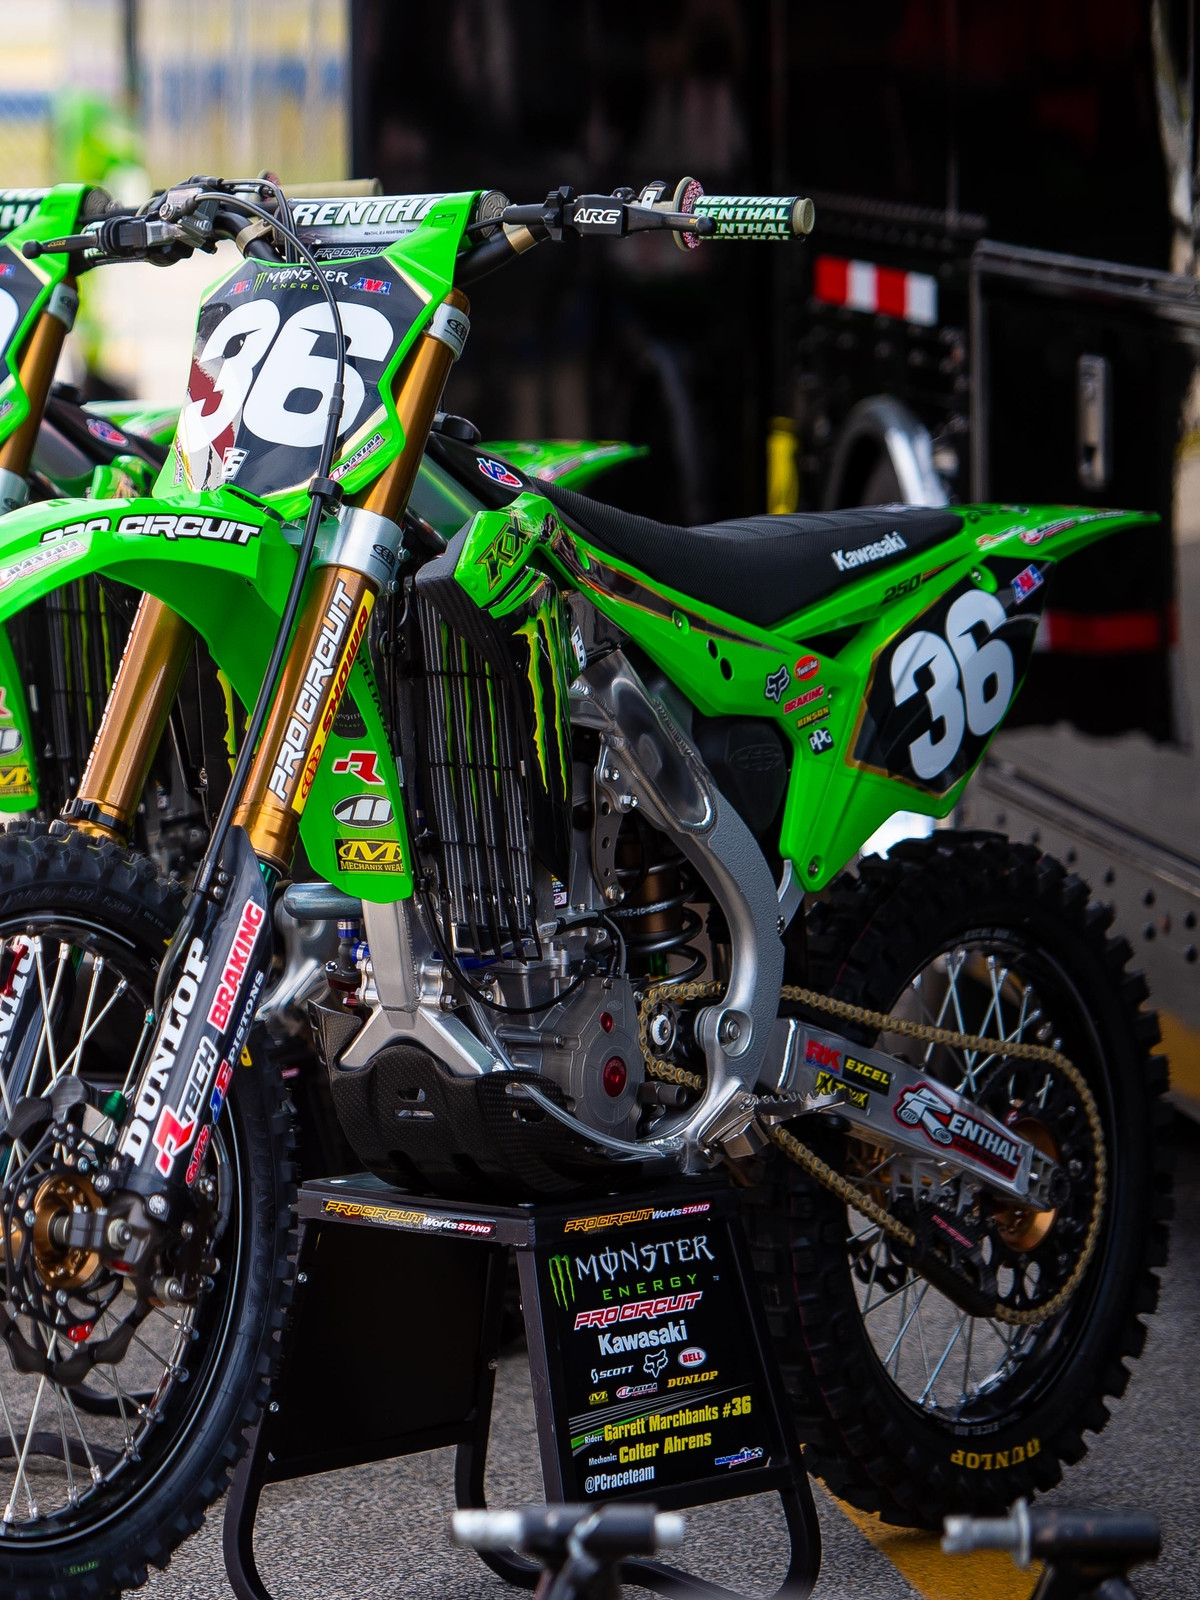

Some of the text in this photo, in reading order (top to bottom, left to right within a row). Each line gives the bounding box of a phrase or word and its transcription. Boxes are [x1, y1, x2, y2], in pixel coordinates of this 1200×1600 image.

[292, 199, 441, 226] RENTHA
[574, 208, 621, 225] ARC
[715, 223, 791, 234] ENTHAL
[272, 282, 320, 291] ENERG
[349, 277, 392, 295] AMA
[184, 298, 394, 449] 36
[118, 514, 263, 545] CIRCUIT
[831, 531, 908, 572] Kawasaki
[882, 572, 922, 602] 250
[322, 604, 370, 740] SHOWA
[890, 588, 1015, 781] 36
[268, 578, 356, 802] PRO CIRCUIT
[340, 860, 383, 871] MECHANIX
[208, 899, 267, 1035] BRAKING
[228, 970, 265, 1066] PISTONS
[120, 937, 209, 1167] DUNLOP
[805, 1039, 843, 1071] RK
[844, 1058, 891, 1086] EXCEL
[325, 1200, 363, 1216] PRO
[361, 1206, 426, 1225] CIRCUIT
[564, 1214, 597, 1233] PRO
[596, 1208, 654, 1230] CIRCUIT
[603, 1273, 698, 1300] ENERGY
[574, 1291, 703, 1330] PRO CIRCUIT
[598, 1320, 688, 1356] Kawasaki
[600, 1365, 634, 1379] SCOTT
[682, 1352, 702, 1364] BELL
[667, 1371, 719, 1388] DUNLOP
[604, 1418, 646, 1442] Garrett
[649, 1405, 719, 1433] Marchbanks
[722, 1396, 752, 1418] #36
[619, 1443, 660, 1464] Colter
[664, 1433, 712, 1455] Ahrens
[951, 1438, 1041, 1470] DUNLOP
[585, 1465, 655, 1494] @PCraceteam
